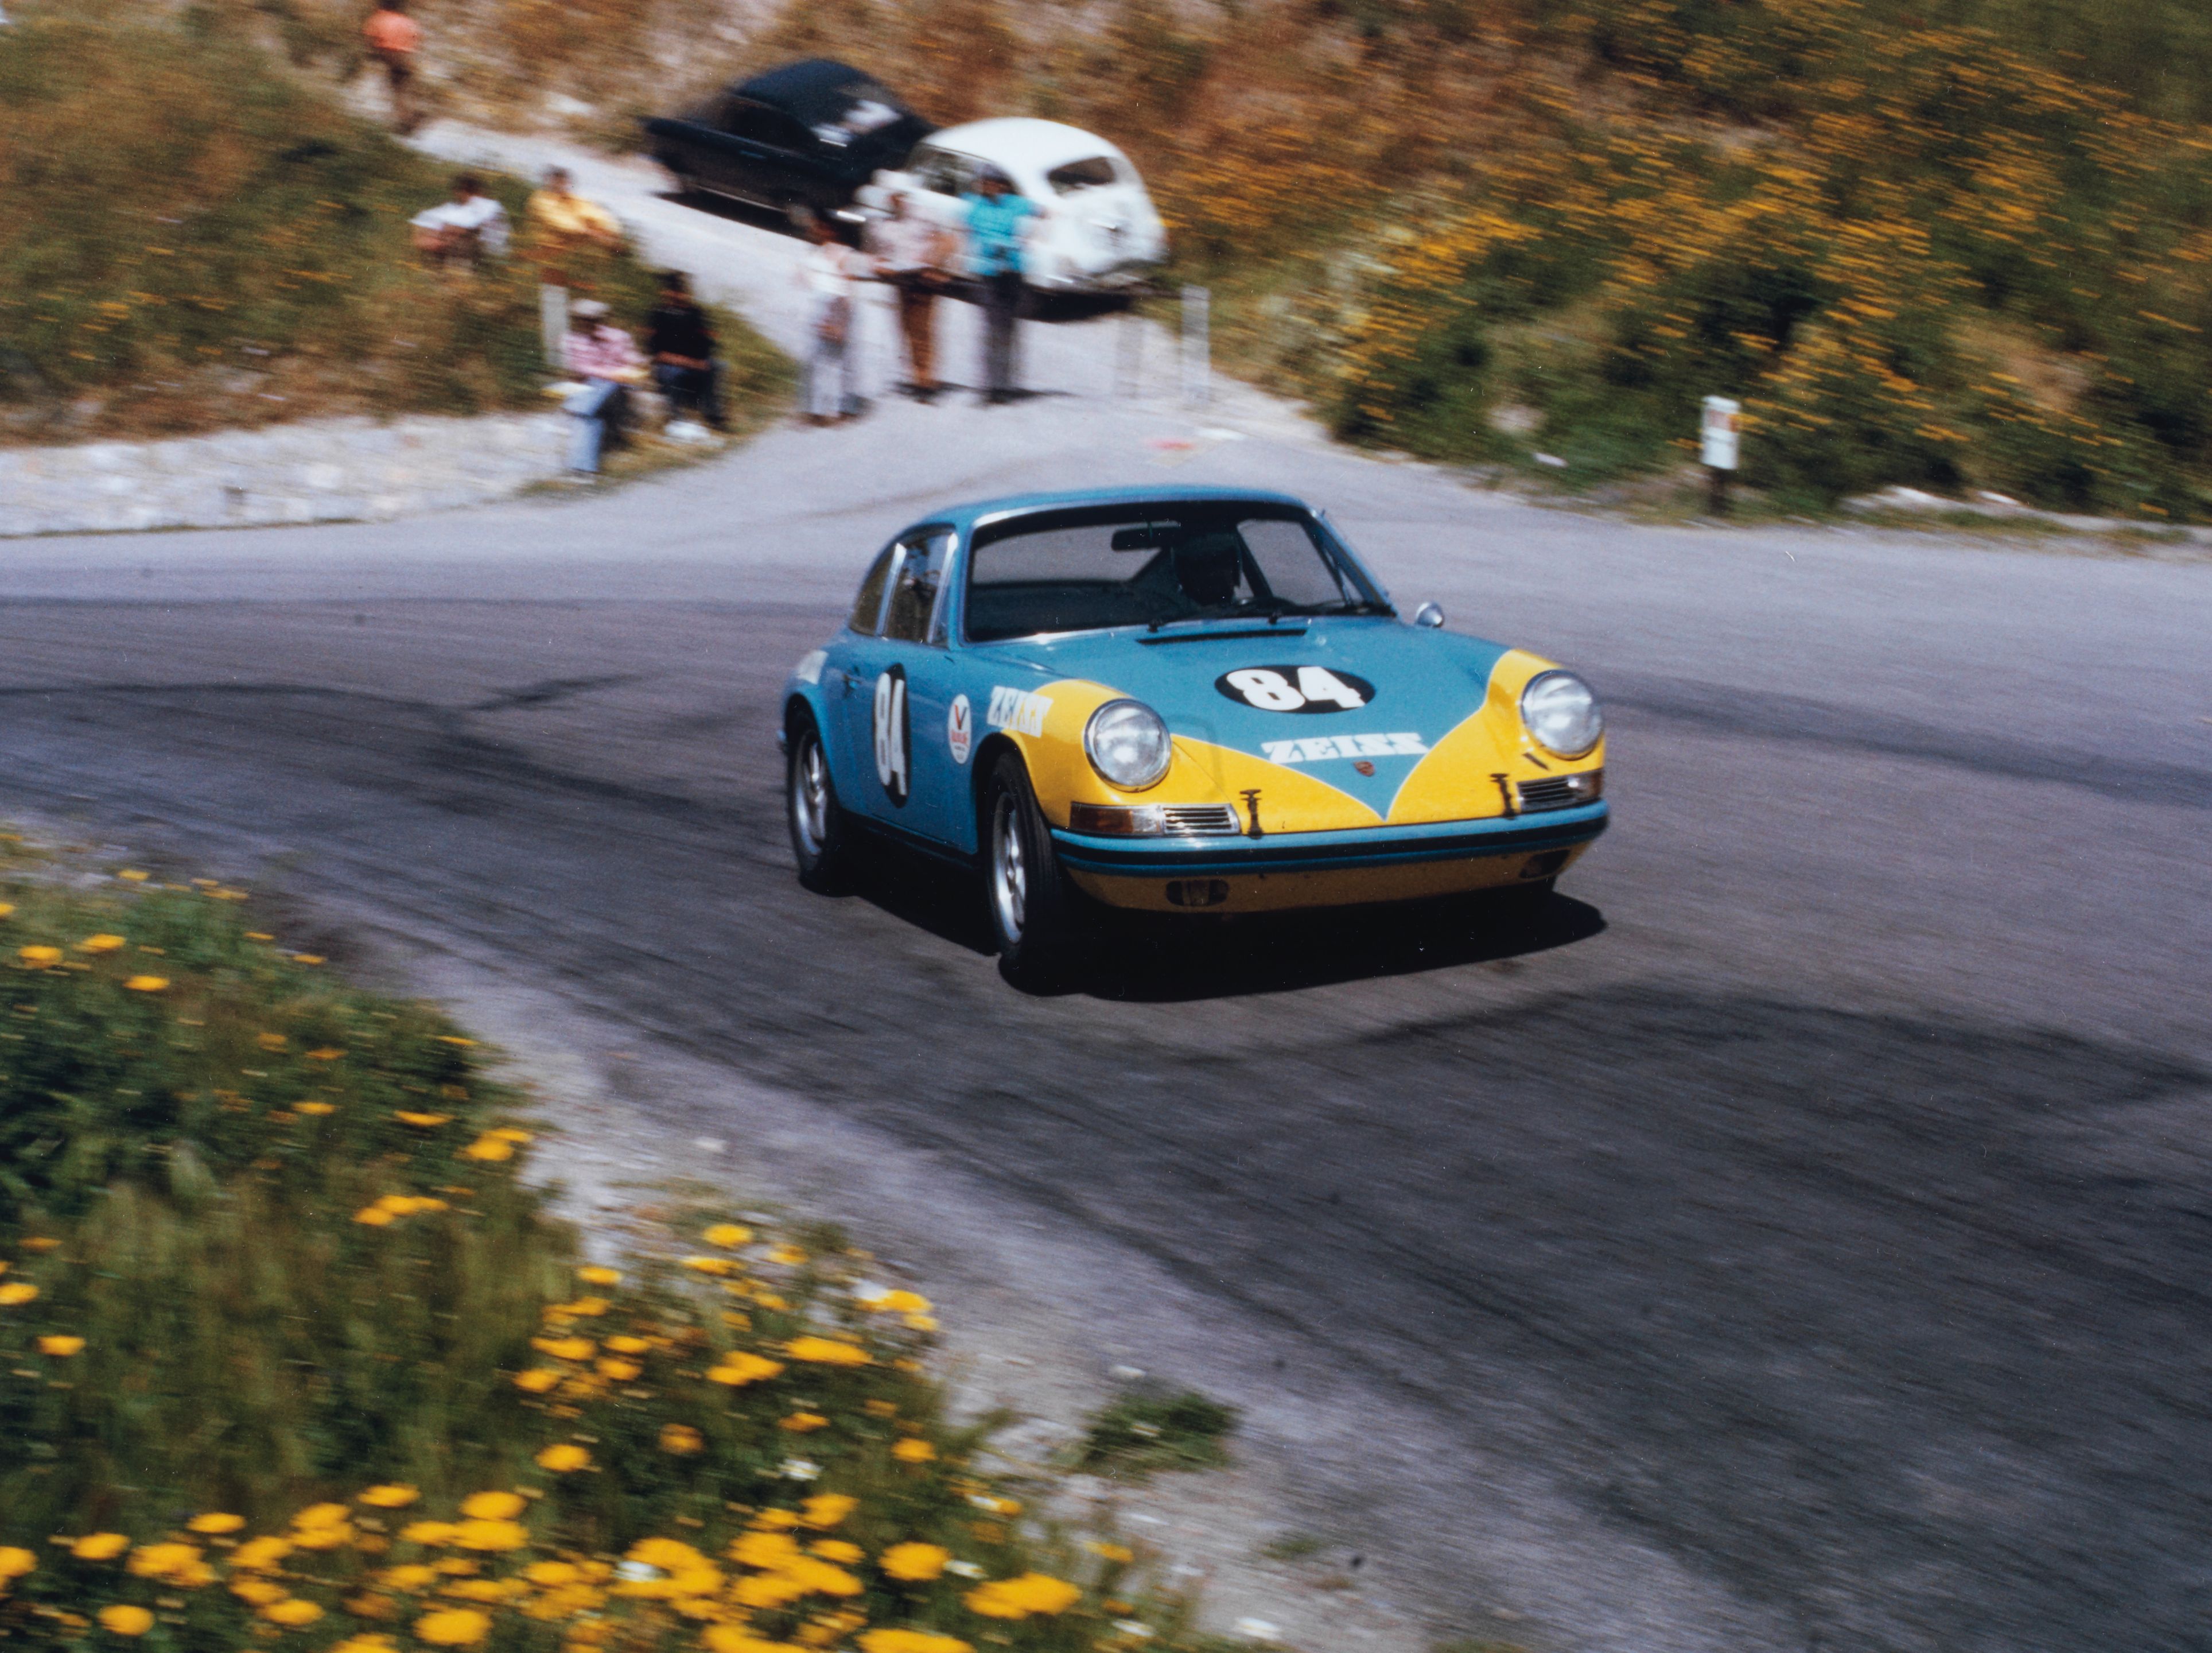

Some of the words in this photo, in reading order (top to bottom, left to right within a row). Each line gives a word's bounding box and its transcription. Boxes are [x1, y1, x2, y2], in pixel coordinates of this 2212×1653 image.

[1226, 666, 1365, 711] 84
[876, 672, 907, 796] 84
[1261, 732, 1429, 764] ZEISS
